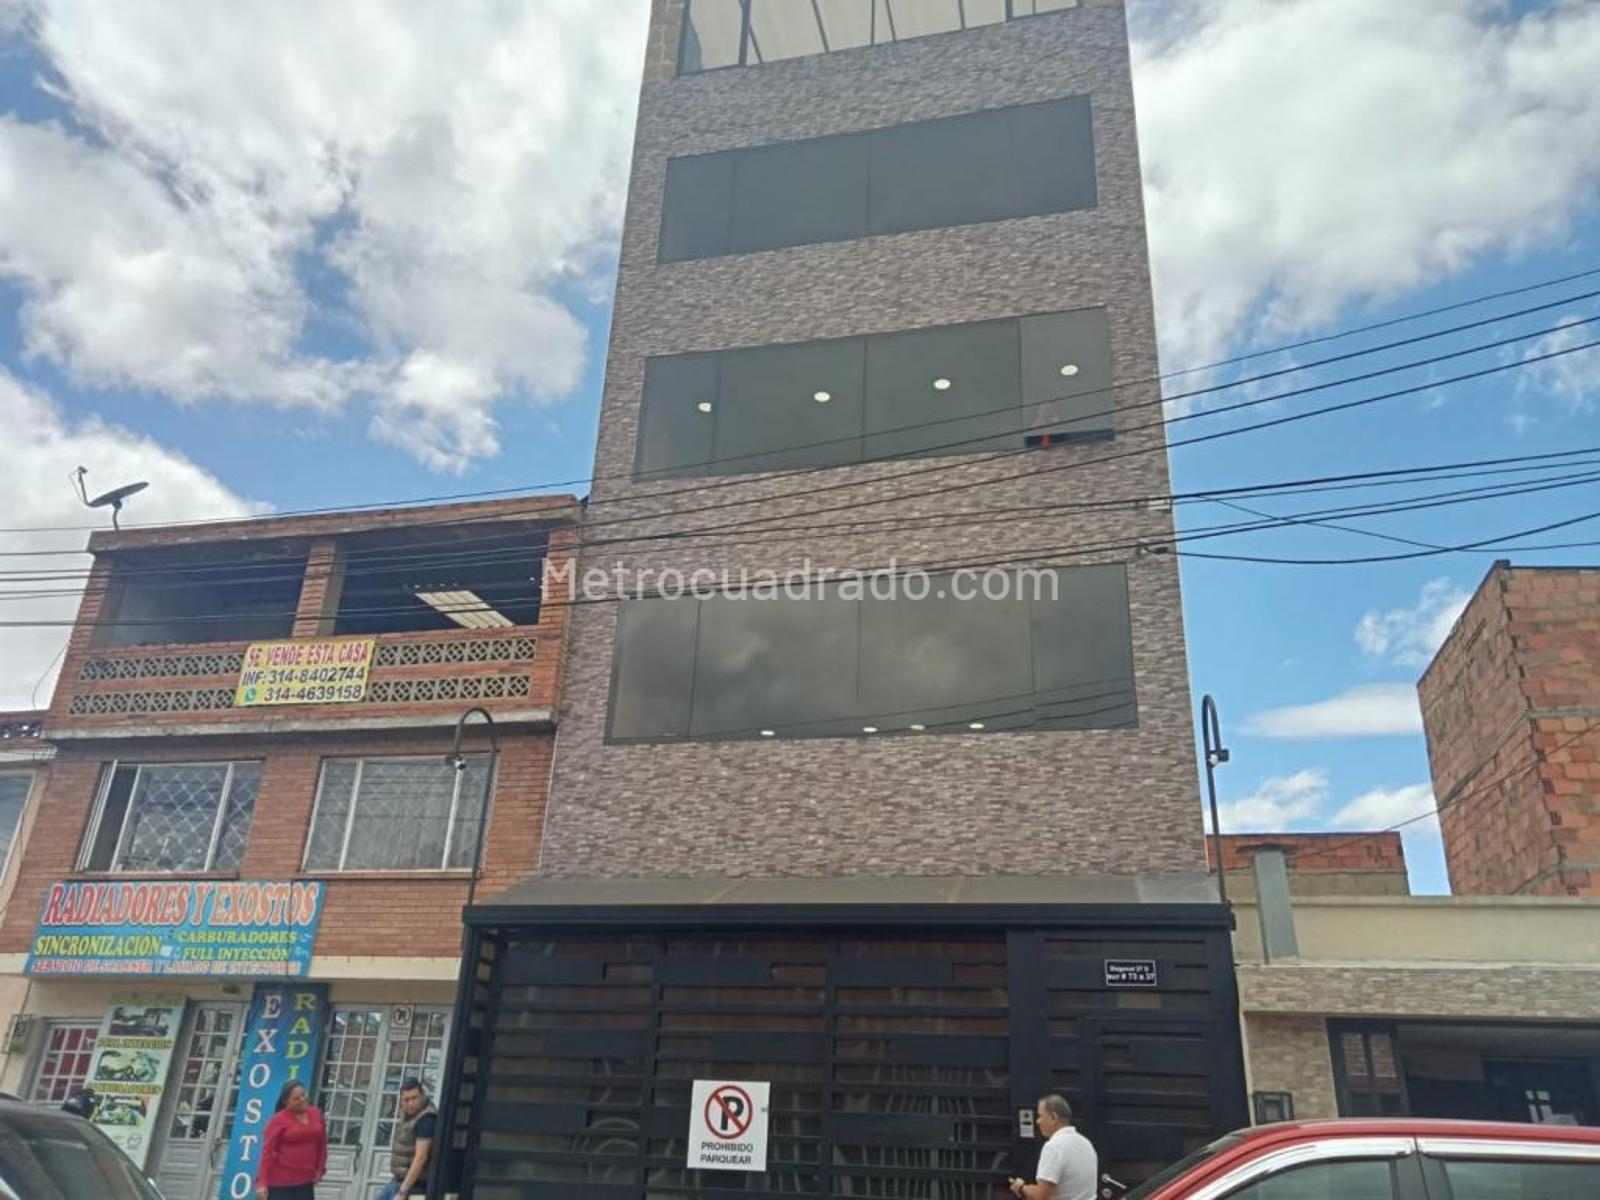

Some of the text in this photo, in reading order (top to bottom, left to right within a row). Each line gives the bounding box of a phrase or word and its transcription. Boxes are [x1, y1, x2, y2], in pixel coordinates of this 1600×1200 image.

[266, 644, 302, 666] VENDE
[305, 642, 335, 664] ESTA
[338, 641, 368, 663] CASA
[268, 666, 366, 684] 314-8402744
[263, 685, 363, 702] 314-4639158
[42, 882, 320, 926] RADIADORES Y EXOSTOS
[176, 929, 298, 944] CARBURADORES
[182, 945, 213, 961] FULL
[700, 1141, 754, 1152] PROHIBIDO
[699, 1153, 752, 1165] PARQUEAR
